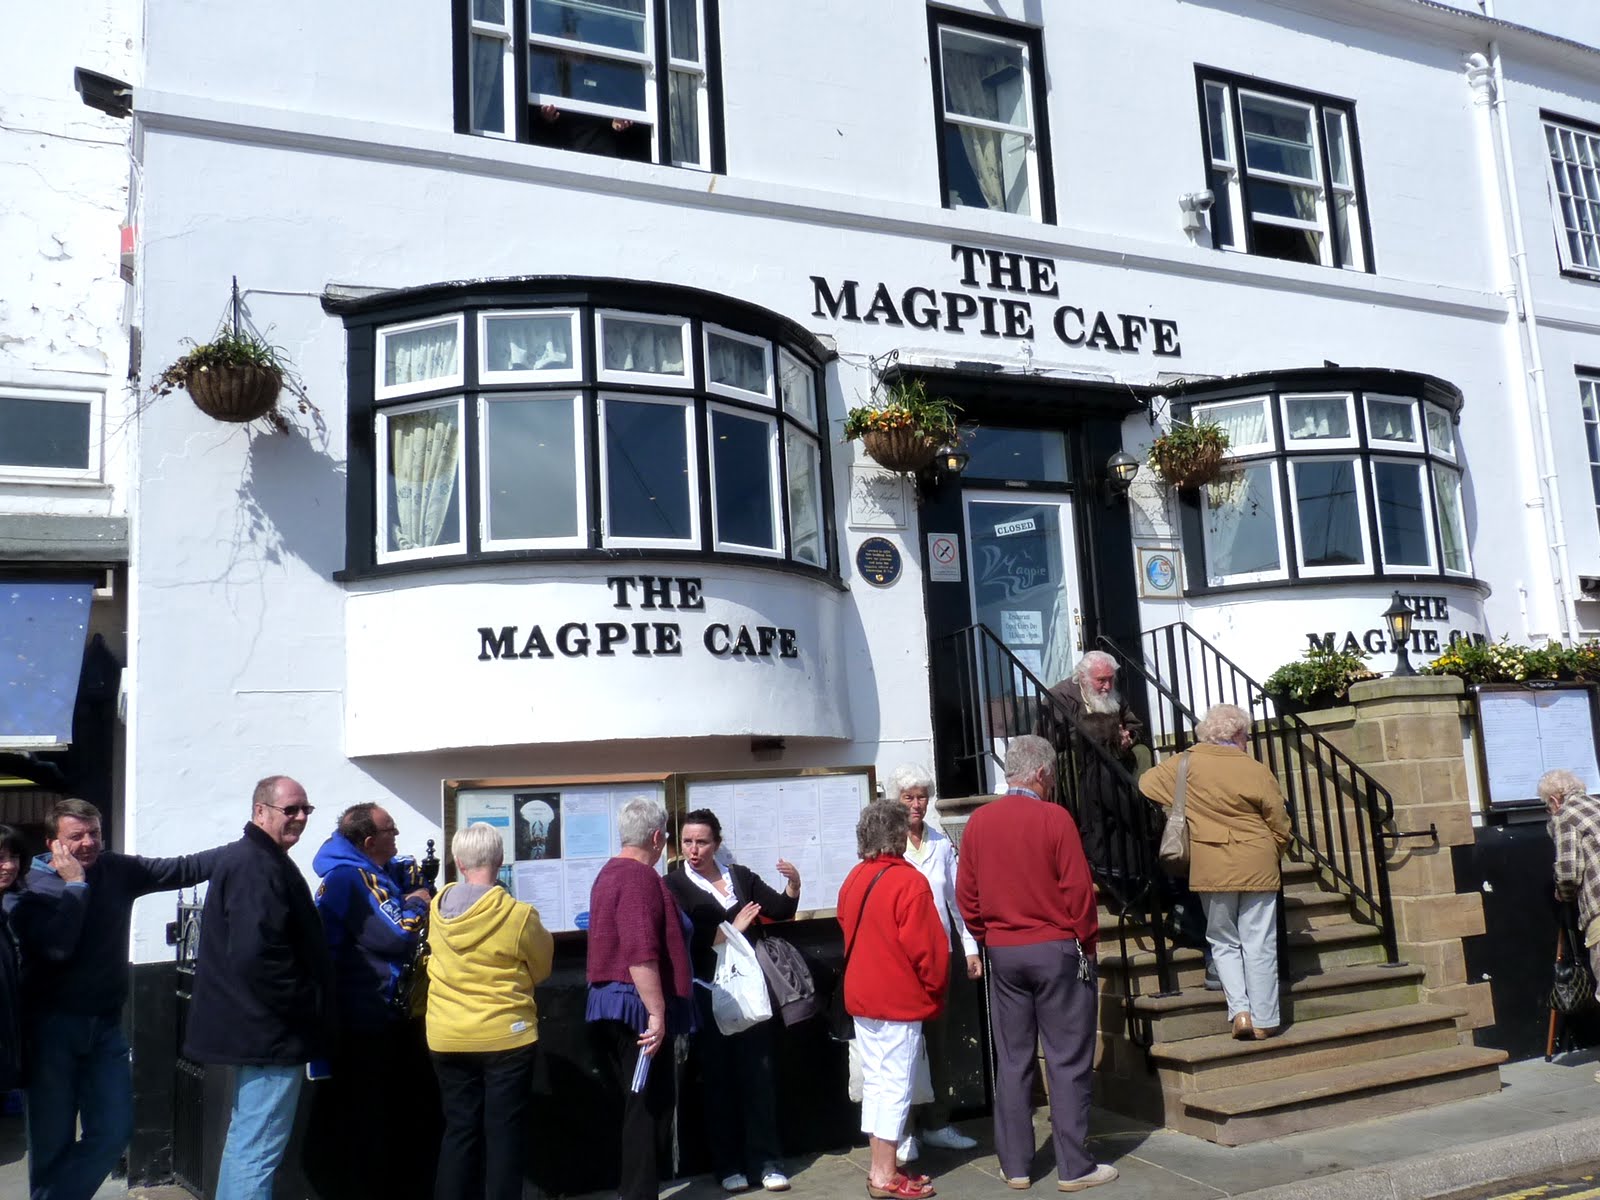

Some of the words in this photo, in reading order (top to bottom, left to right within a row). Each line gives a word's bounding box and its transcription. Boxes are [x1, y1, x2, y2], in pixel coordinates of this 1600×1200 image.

[951, 244, 1059, 296] THE
[809, 275, 1034, 340] MAGPIE
[1053, 305, 1182, 357] CAFE
[997, 521, 1034, 534] CLOSED
[607, 575, 704, 609] THE
[478, 622, 681, 660] MAGPIE
[703, 623, 798, 658] CAFE
